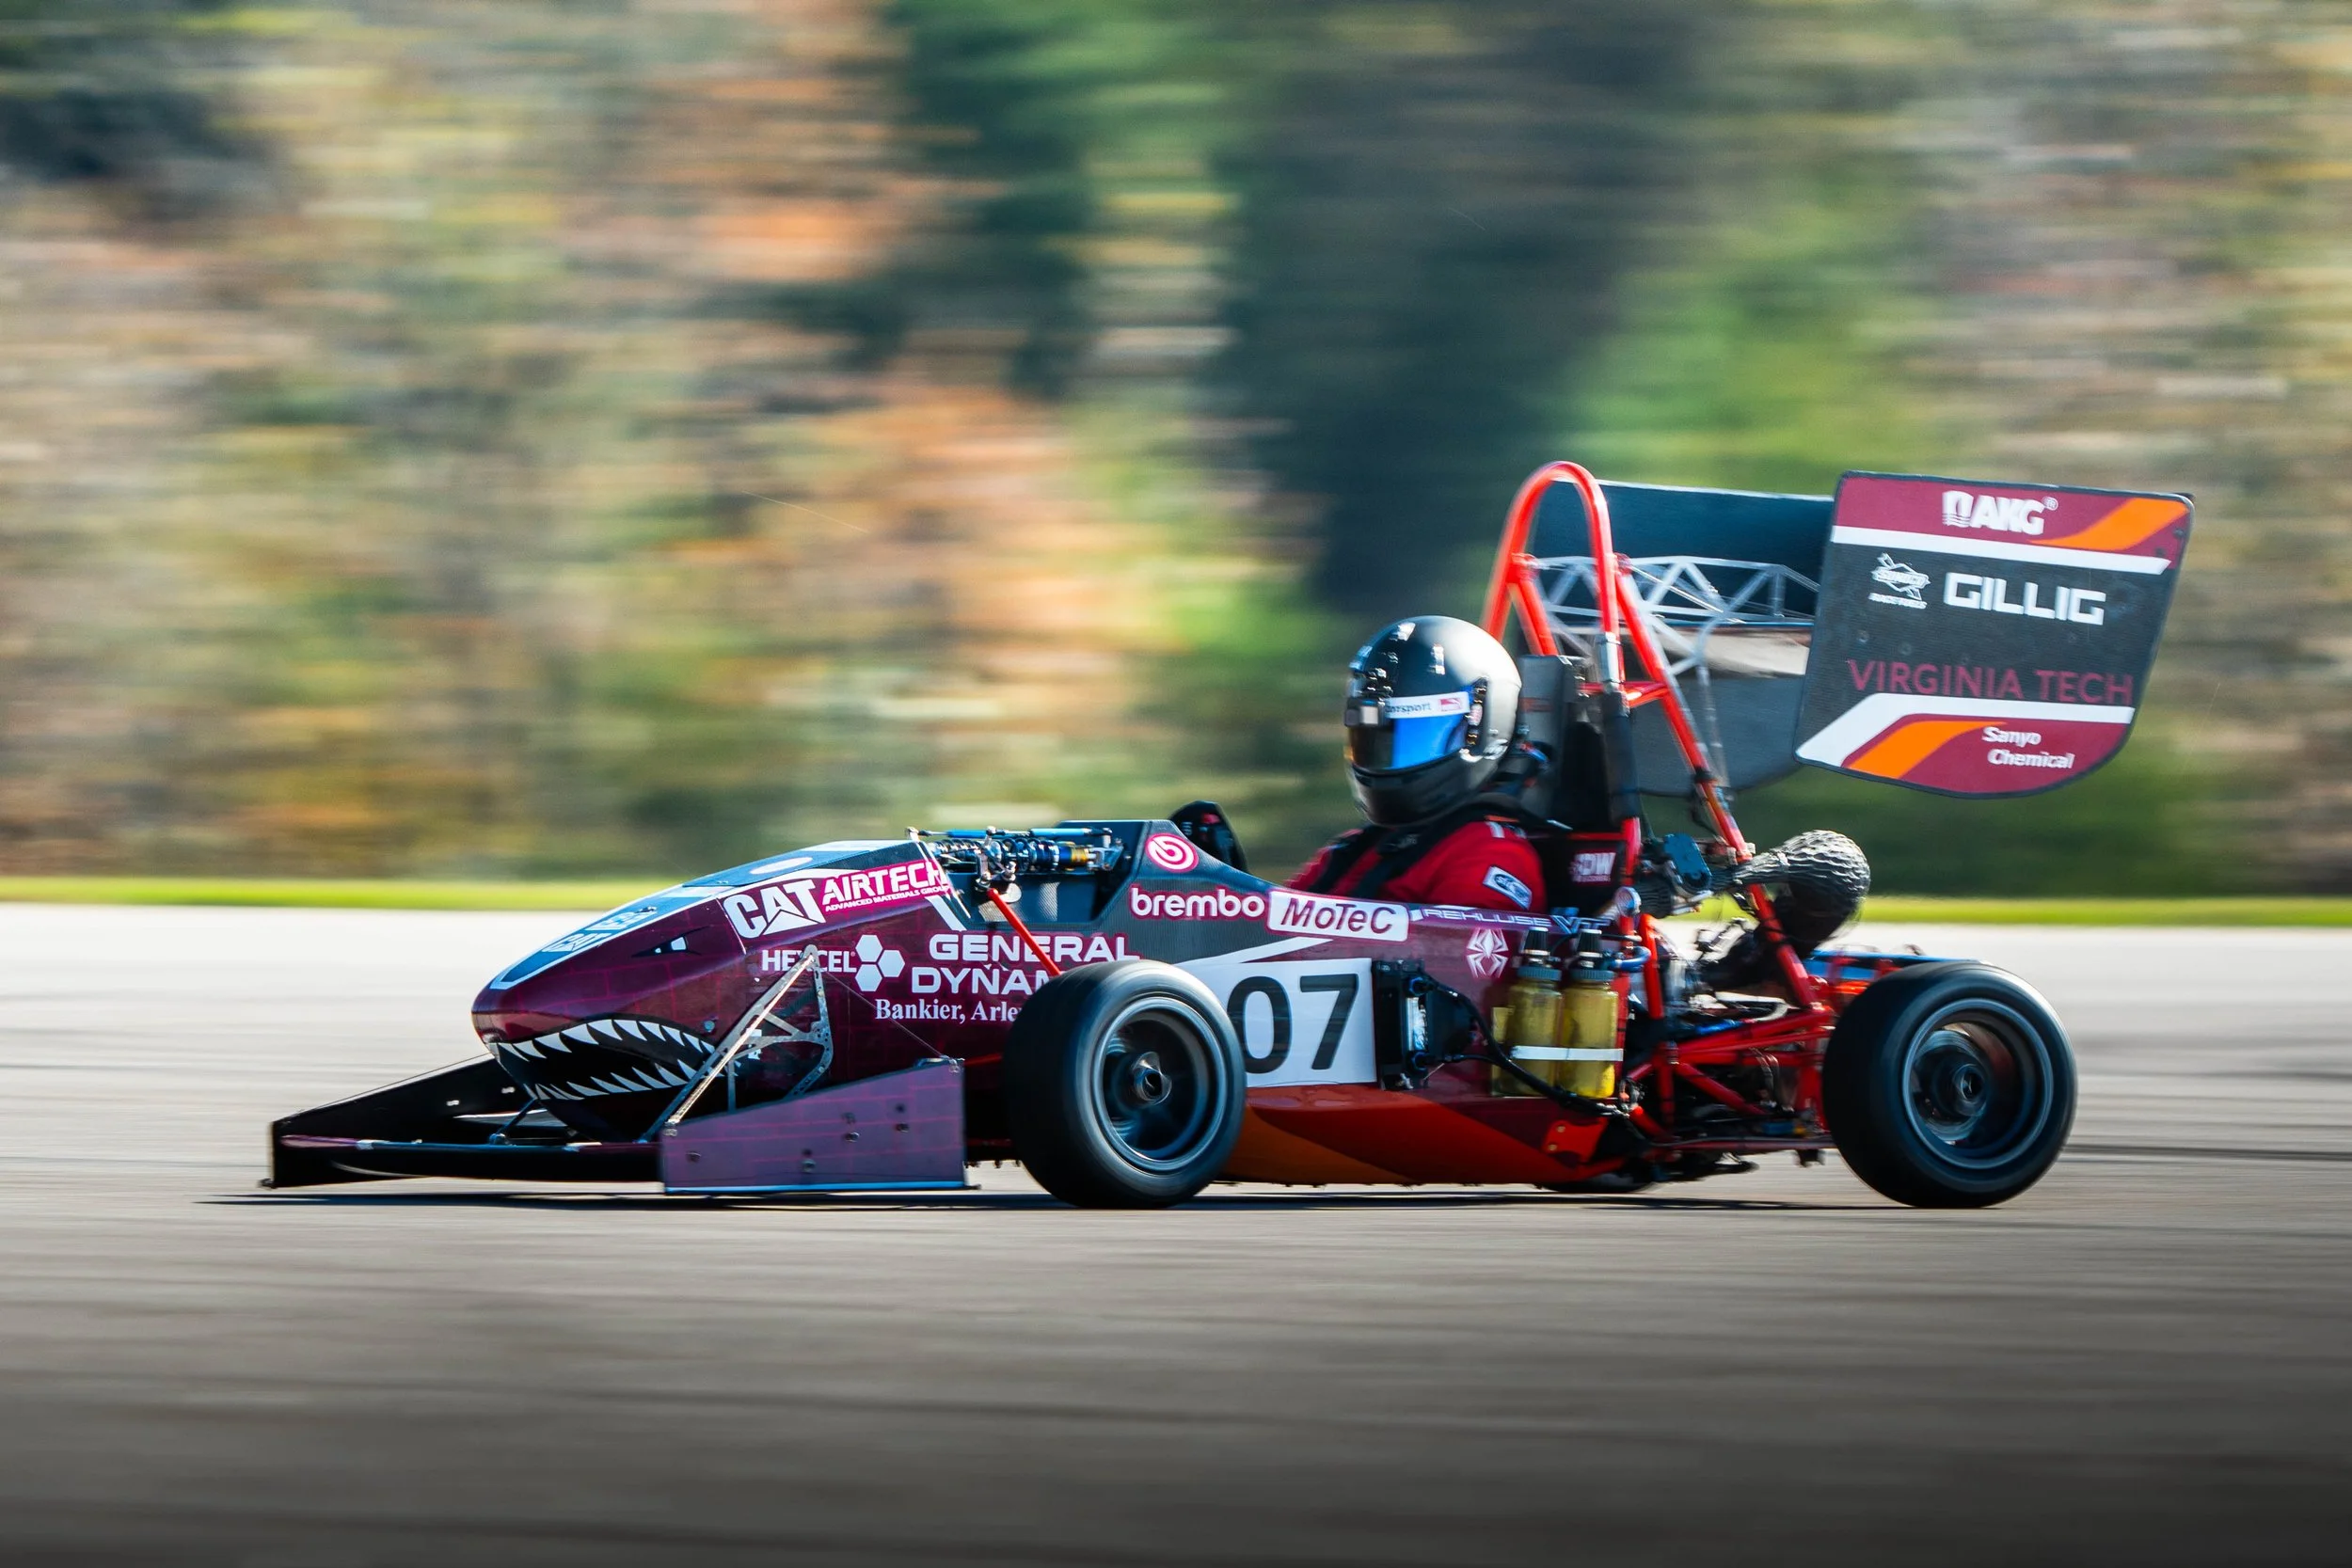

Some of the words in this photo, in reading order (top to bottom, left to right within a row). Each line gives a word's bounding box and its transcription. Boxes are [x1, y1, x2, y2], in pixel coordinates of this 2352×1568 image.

[1944, 571, 2106, 626] GILLIG
[1848, 659, 2024, 700] VIRGINIA
[2035, 670, 2134, 705] TECH
[1981, 726, 2042, 748] Sanyo
[1987, 749, 2075, 768] Chemical
[822, 862, 948, 905] AIRTECH
[723, 879, 826, 939] CAT
[825, 898, 873, 912] ADVANCED
[873, 890, 920, 904] MATERIALS
[1131, 888, 1264, 917] brembo
[1280, 897, 1397, 934] MoTeC
[762, 949, 857, 973] HECEL
[930, 934, 1139, 961] GENERAL
[875, 998, 966, 1024] Bankier,
[970, 1000, 1022, 1022] Arle
[1227, 974, 1359, 1074] 07
